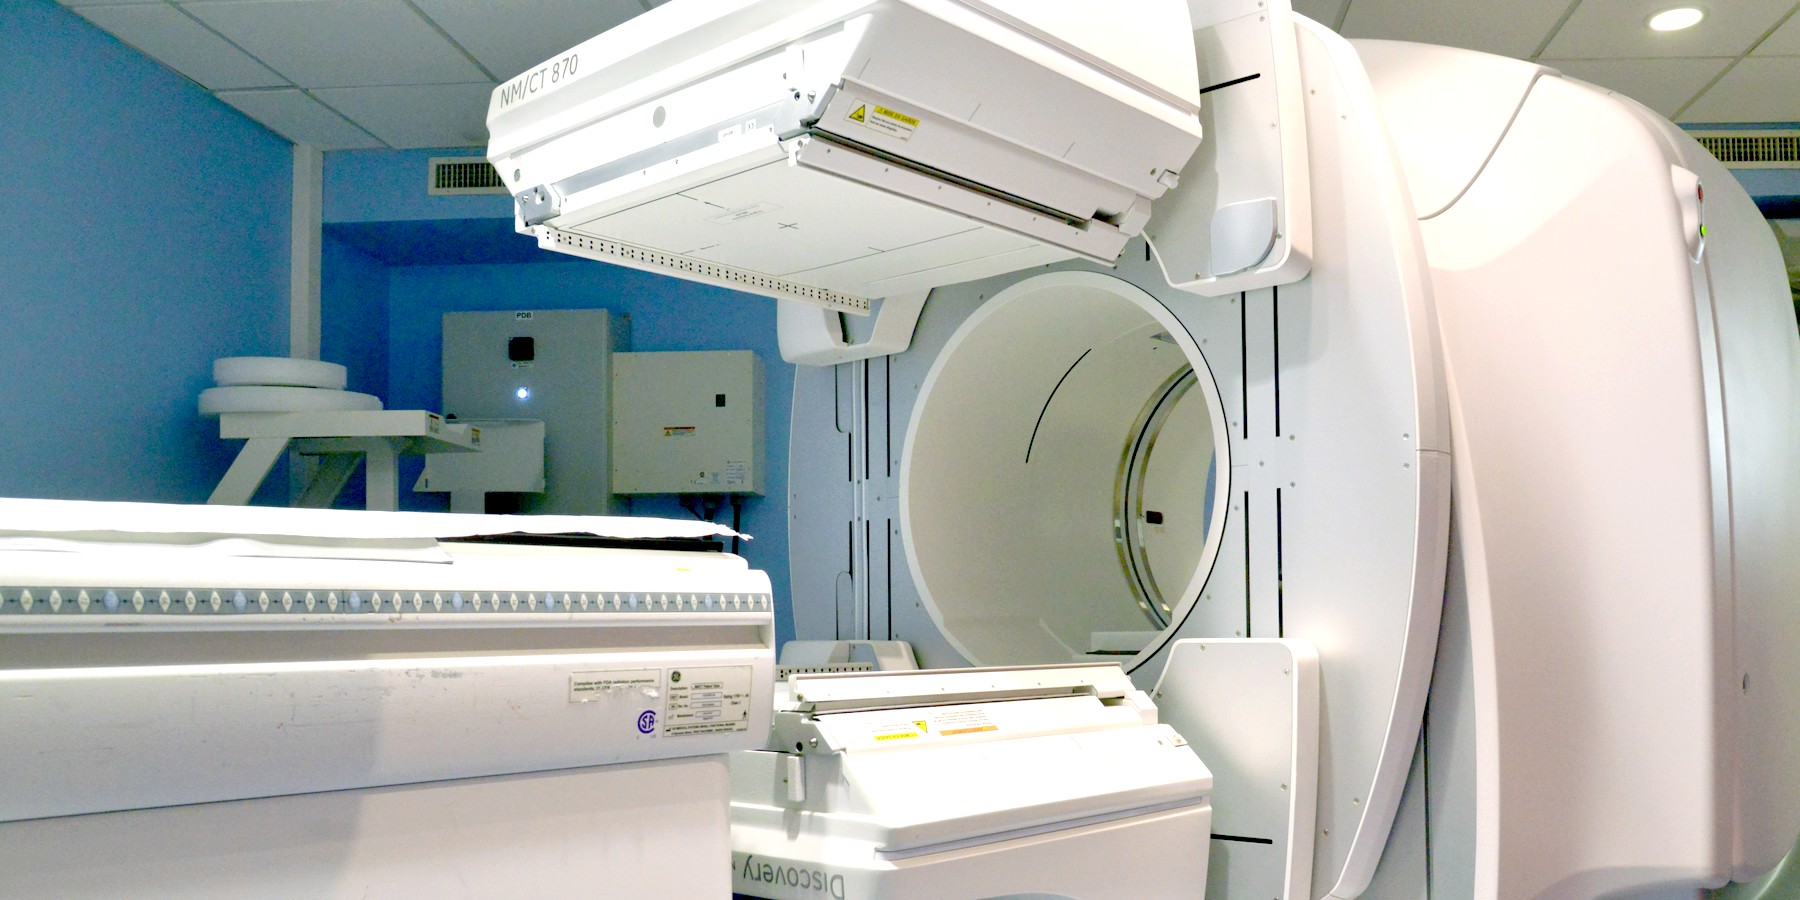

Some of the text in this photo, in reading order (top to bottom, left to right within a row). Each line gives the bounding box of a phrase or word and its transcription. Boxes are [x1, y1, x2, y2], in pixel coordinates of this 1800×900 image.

[500, 53, 578, 108] NM/CT 870
[743, 855, 845, 900] Discovery
